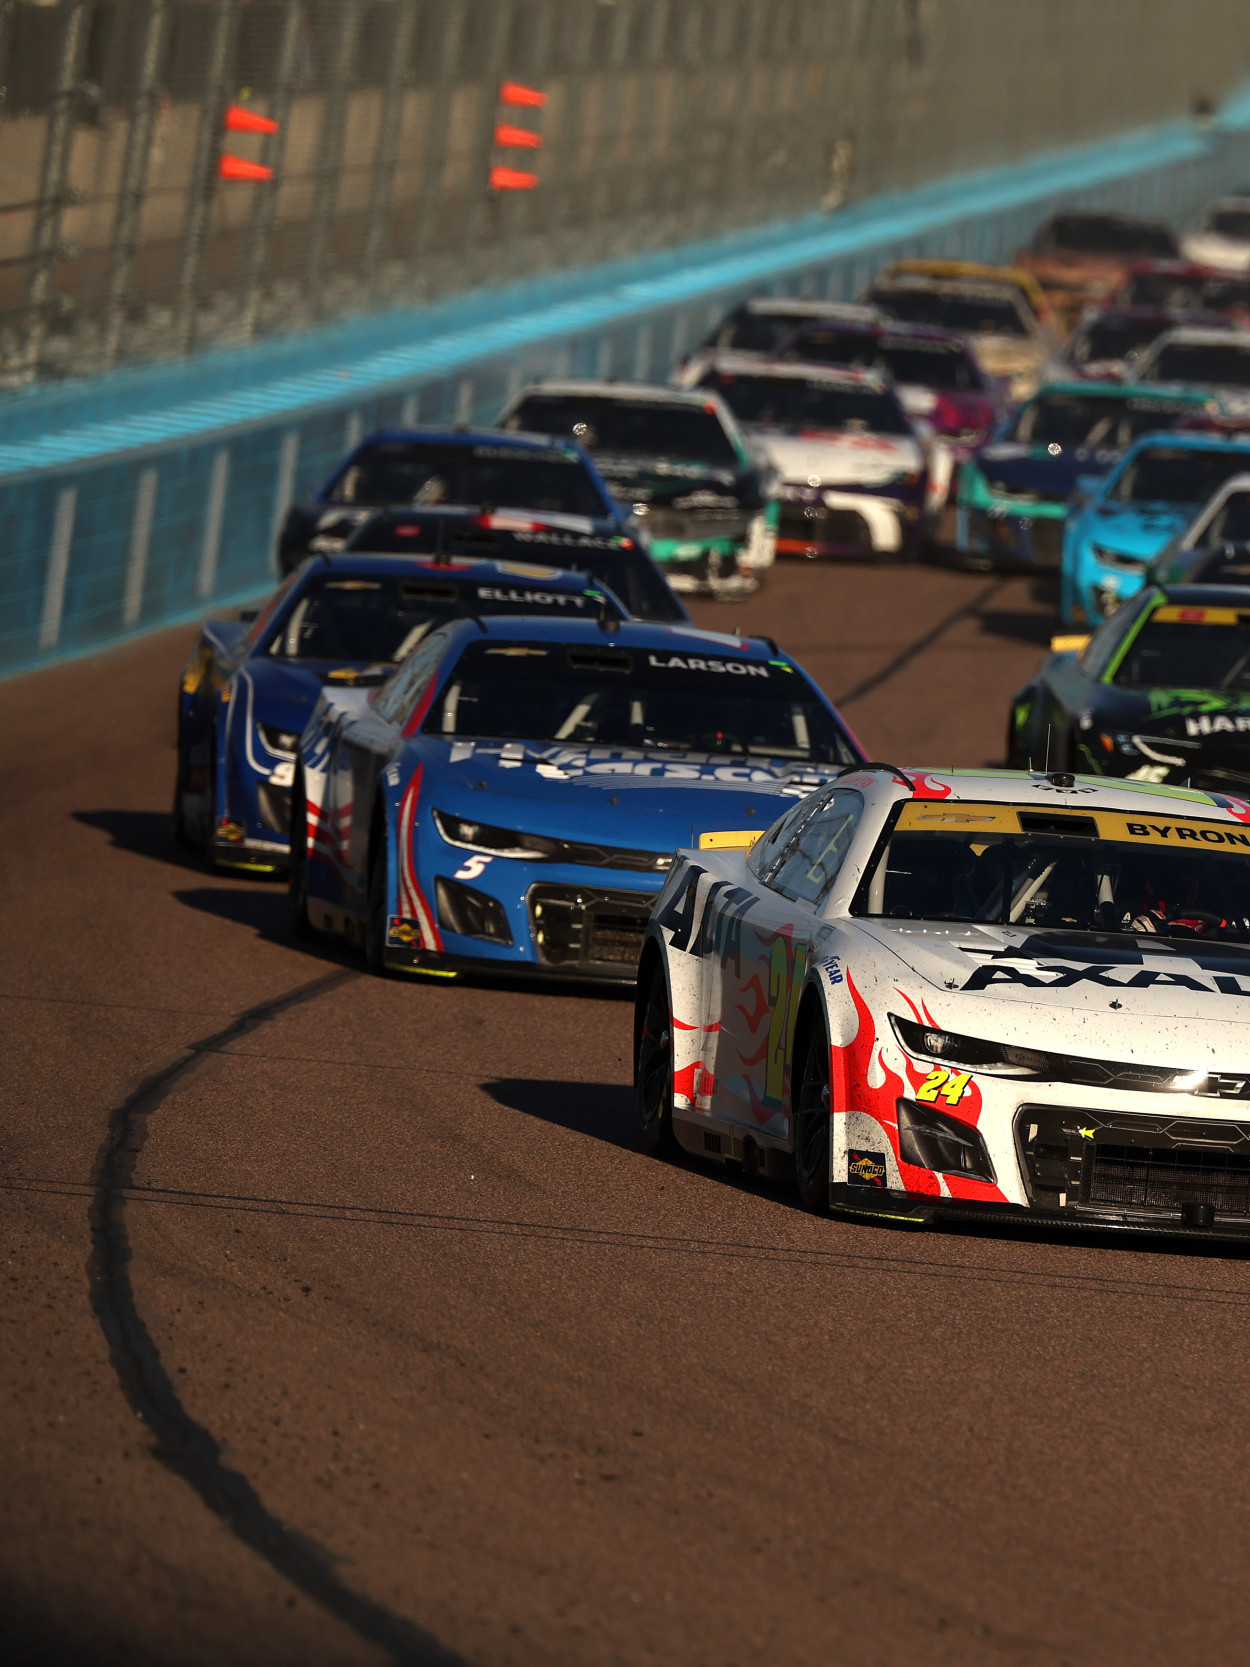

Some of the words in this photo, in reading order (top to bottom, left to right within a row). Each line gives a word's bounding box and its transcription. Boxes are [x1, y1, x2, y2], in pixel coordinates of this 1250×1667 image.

[478, 587, 587, 608] ELLIOTT
[649, 655, 770, 678] LARSON
[454, 855, 494, 880] 5
[915, 1070, 974, 1107] 24
[850, 1163, 885, 1176] SUNOCO
